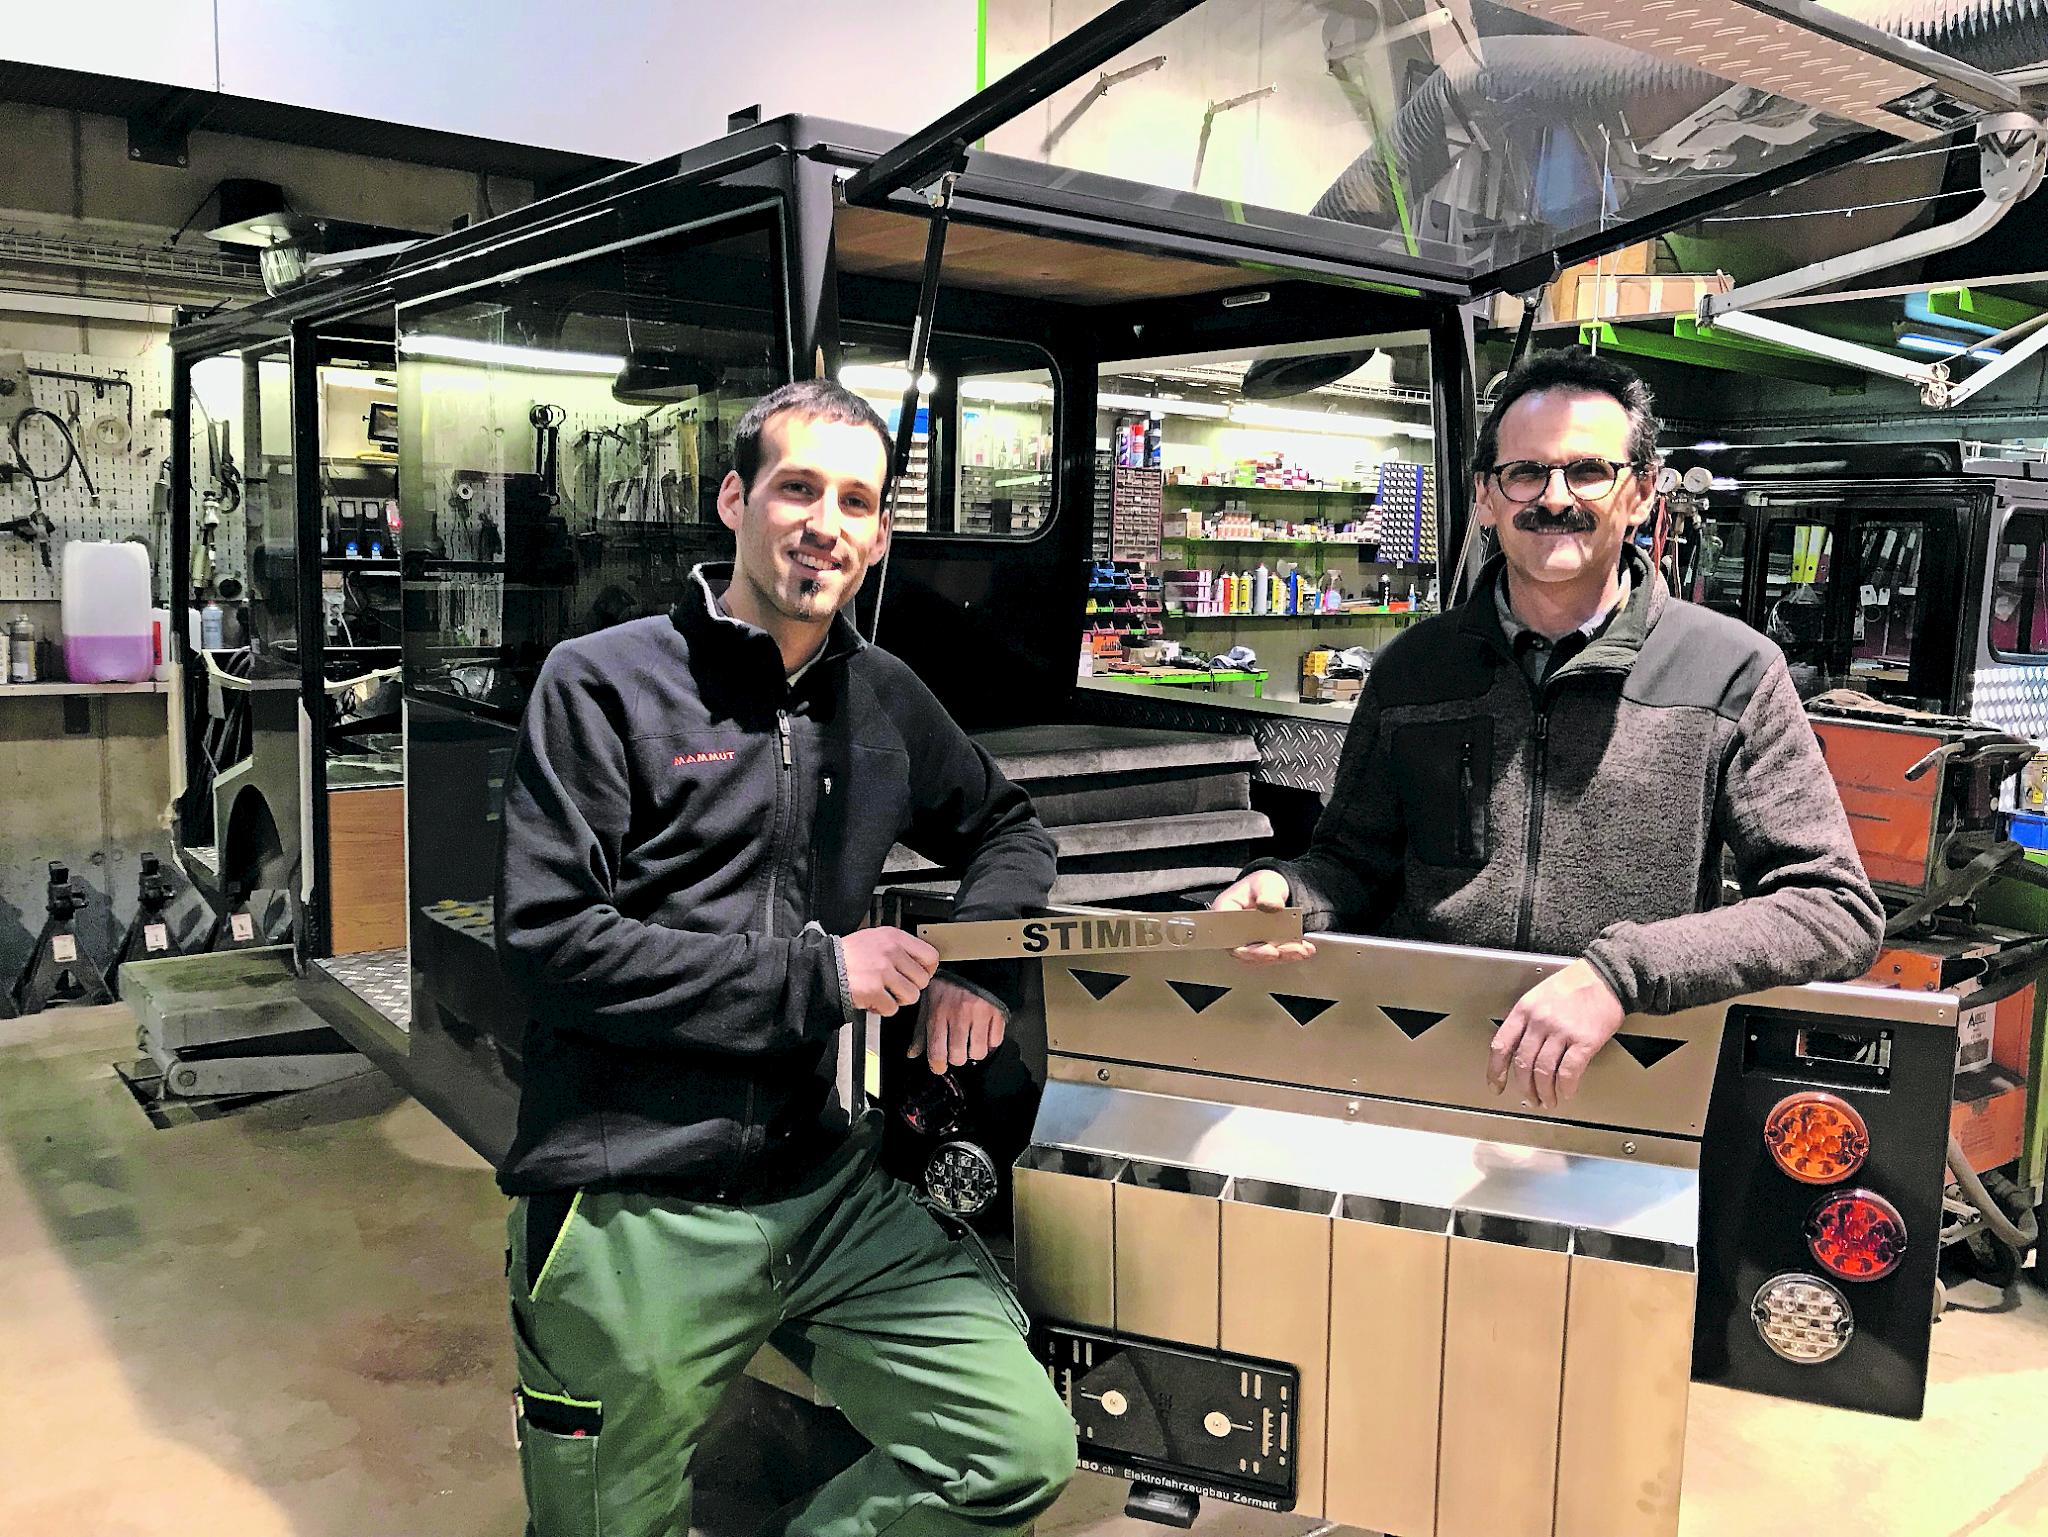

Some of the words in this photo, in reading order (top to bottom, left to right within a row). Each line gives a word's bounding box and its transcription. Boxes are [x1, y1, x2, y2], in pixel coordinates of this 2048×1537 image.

[673, 750, 736, 766] MAMMUT
[1022, 917, 1197, 953] STIMBO
[1123, 1468, 1231, 1501] Elektrofahrzeugbau
[1233, 1492, 1278, 1511] Zermatt
